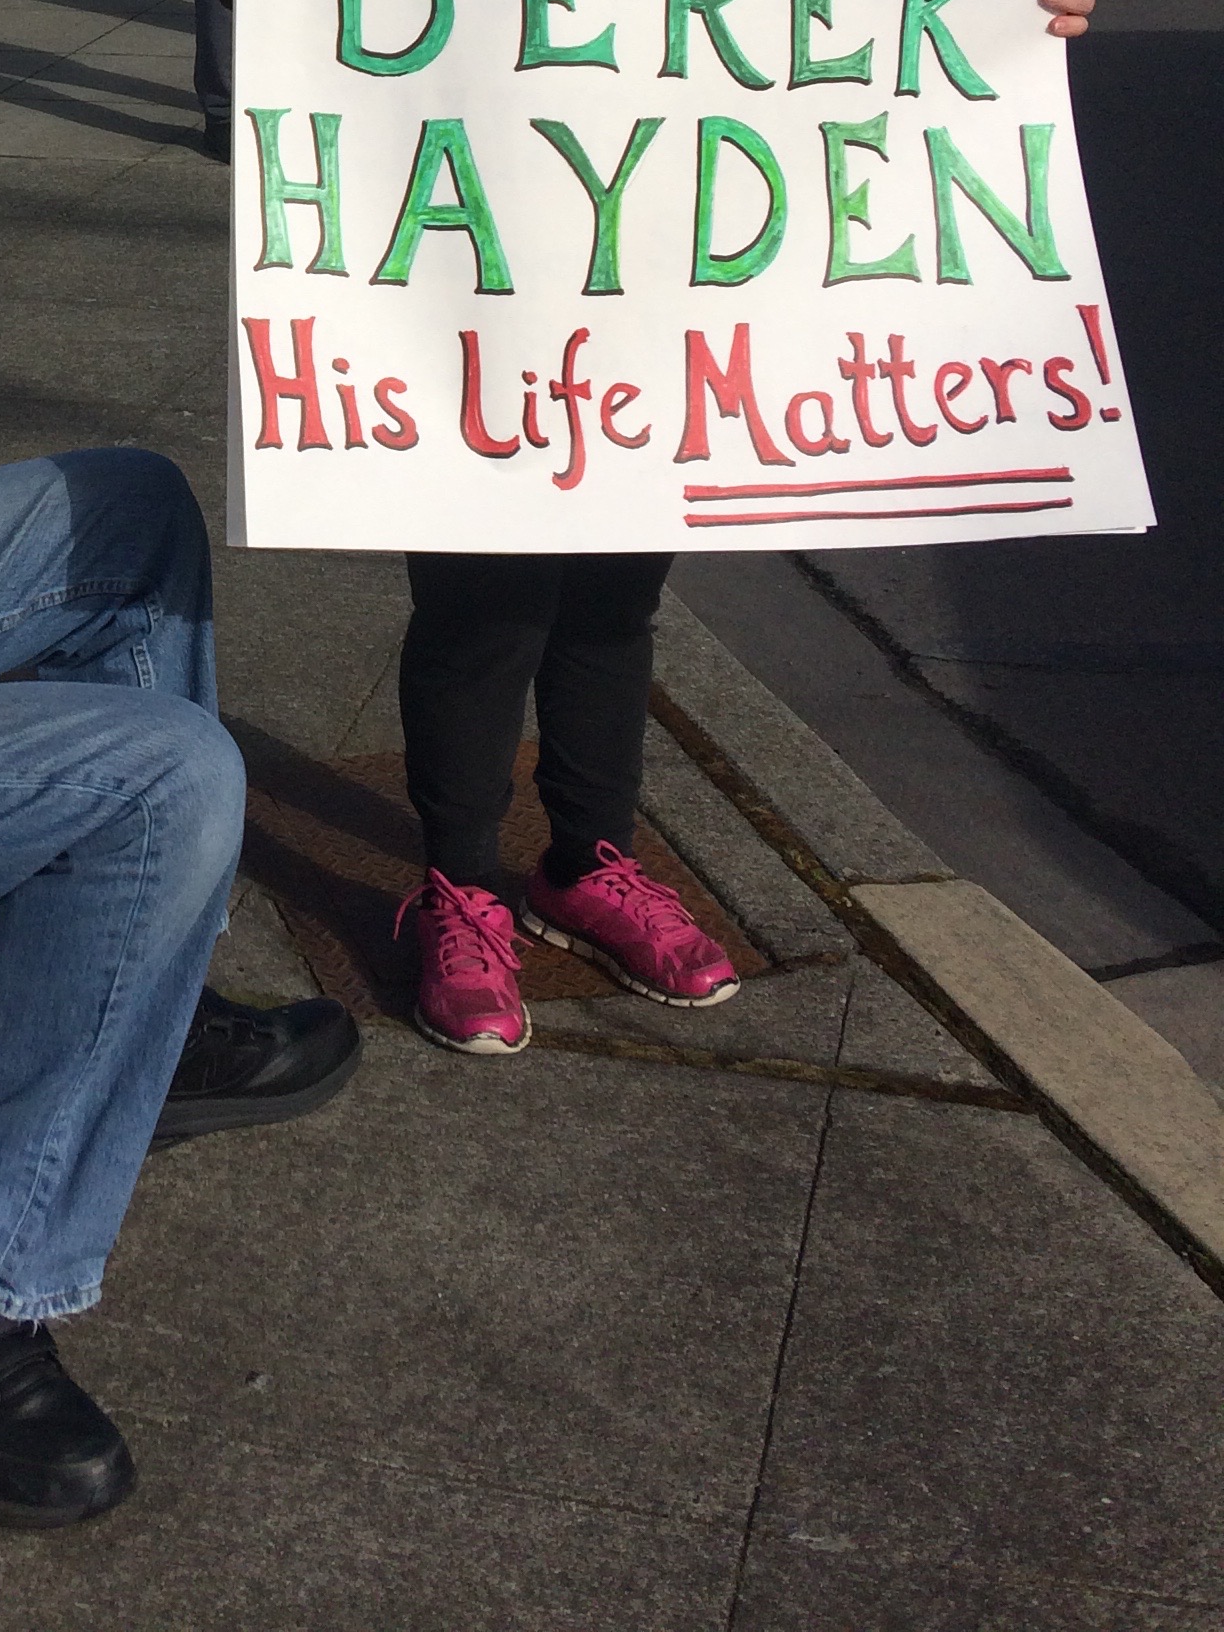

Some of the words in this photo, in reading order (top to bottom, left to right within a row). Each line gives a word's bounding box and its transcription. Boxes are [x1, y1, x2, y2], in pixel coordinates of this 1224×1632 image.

[244, 107, 1072, 297] HAYDEN
[242, 315, 420, 453] His
[458, 326, 652, 491] Life
[672, 304, 1122, 467] Matters!
